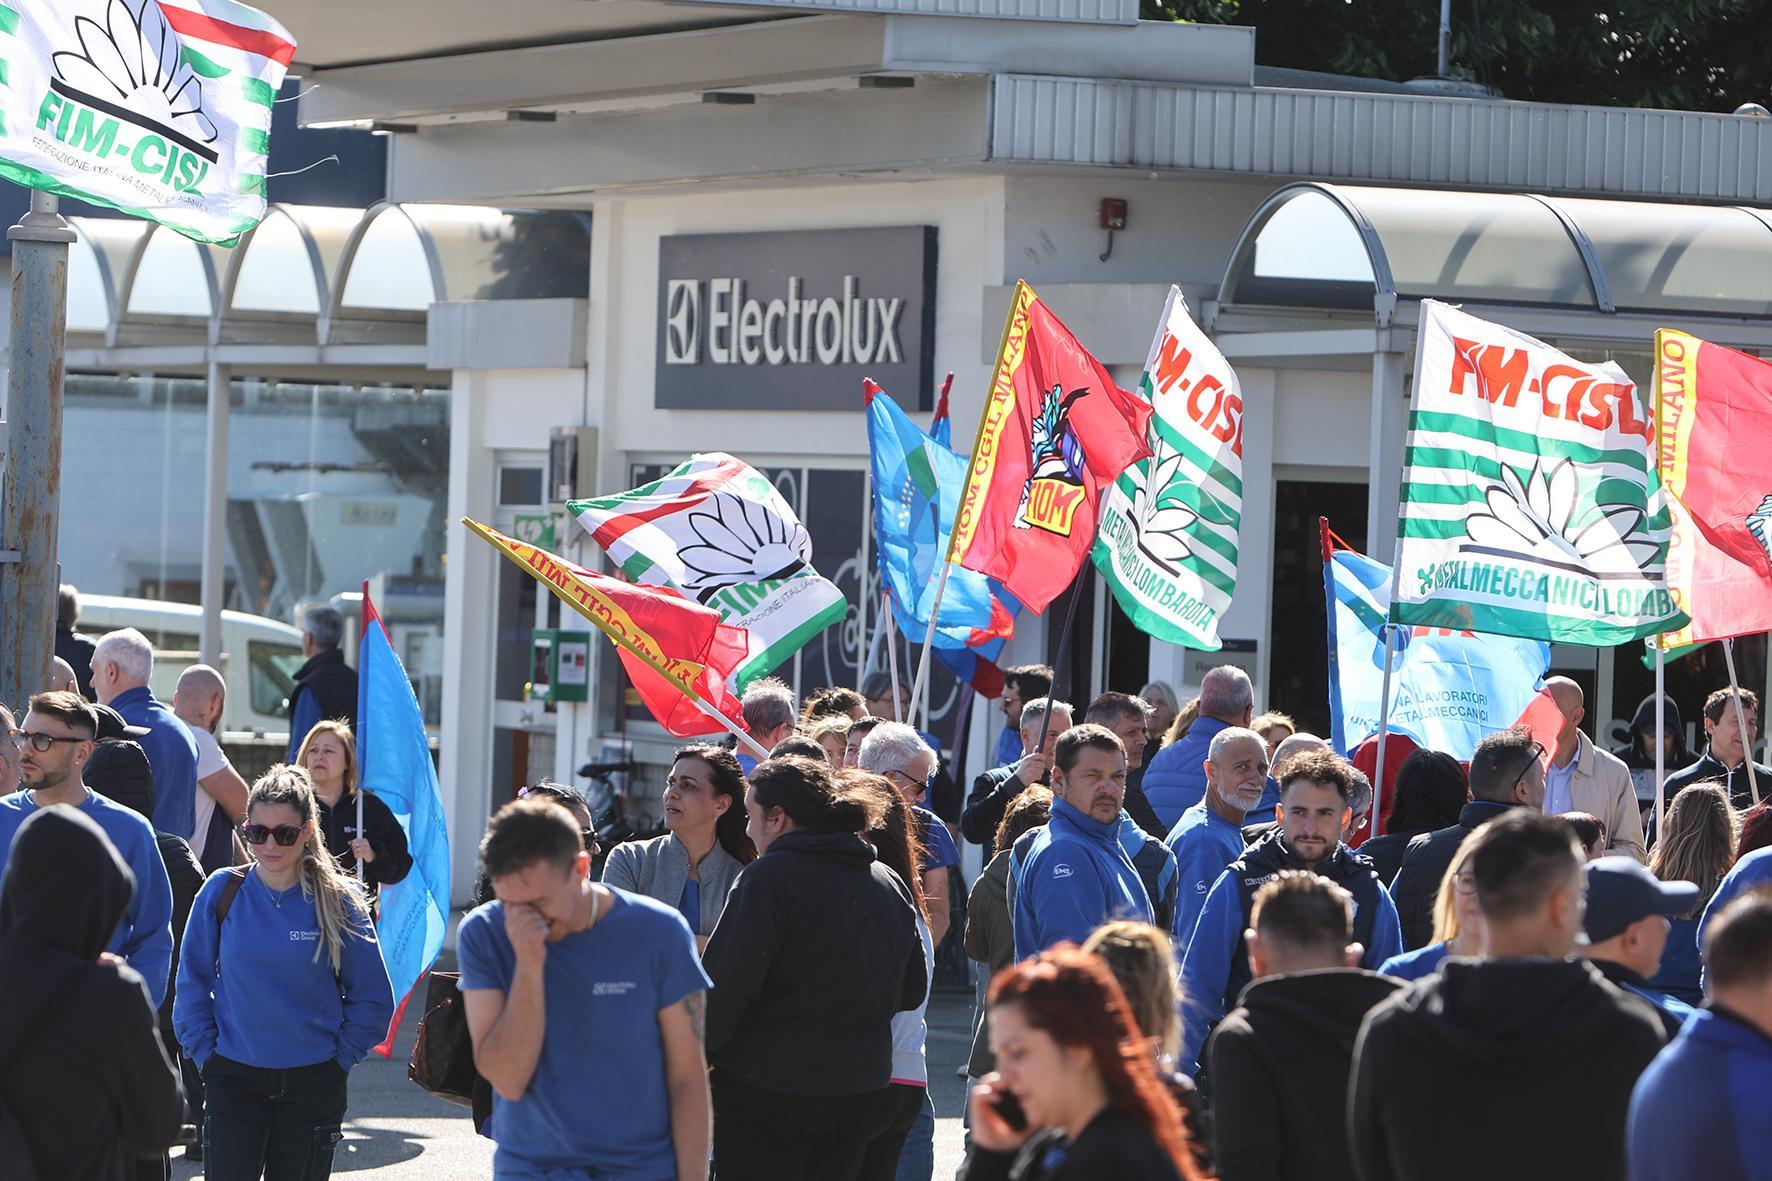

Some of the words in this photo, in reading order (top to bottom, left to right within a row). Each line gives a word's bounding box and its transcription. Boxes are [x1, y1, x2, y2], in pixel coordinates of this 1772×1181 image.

[36, 90, 208, 198] FIM-CISL
[709, 275, 900, 365] Electrolux
[1662, 339, 1686, 472] MILANO
[975, 411, 1002, 477] CGIL
[1395, 705, 1489, 725] ETALMECCANICI
[1415, 690, 1488, 717] LAVORATORI
[1244, 873, 1274, 886] Kapp
